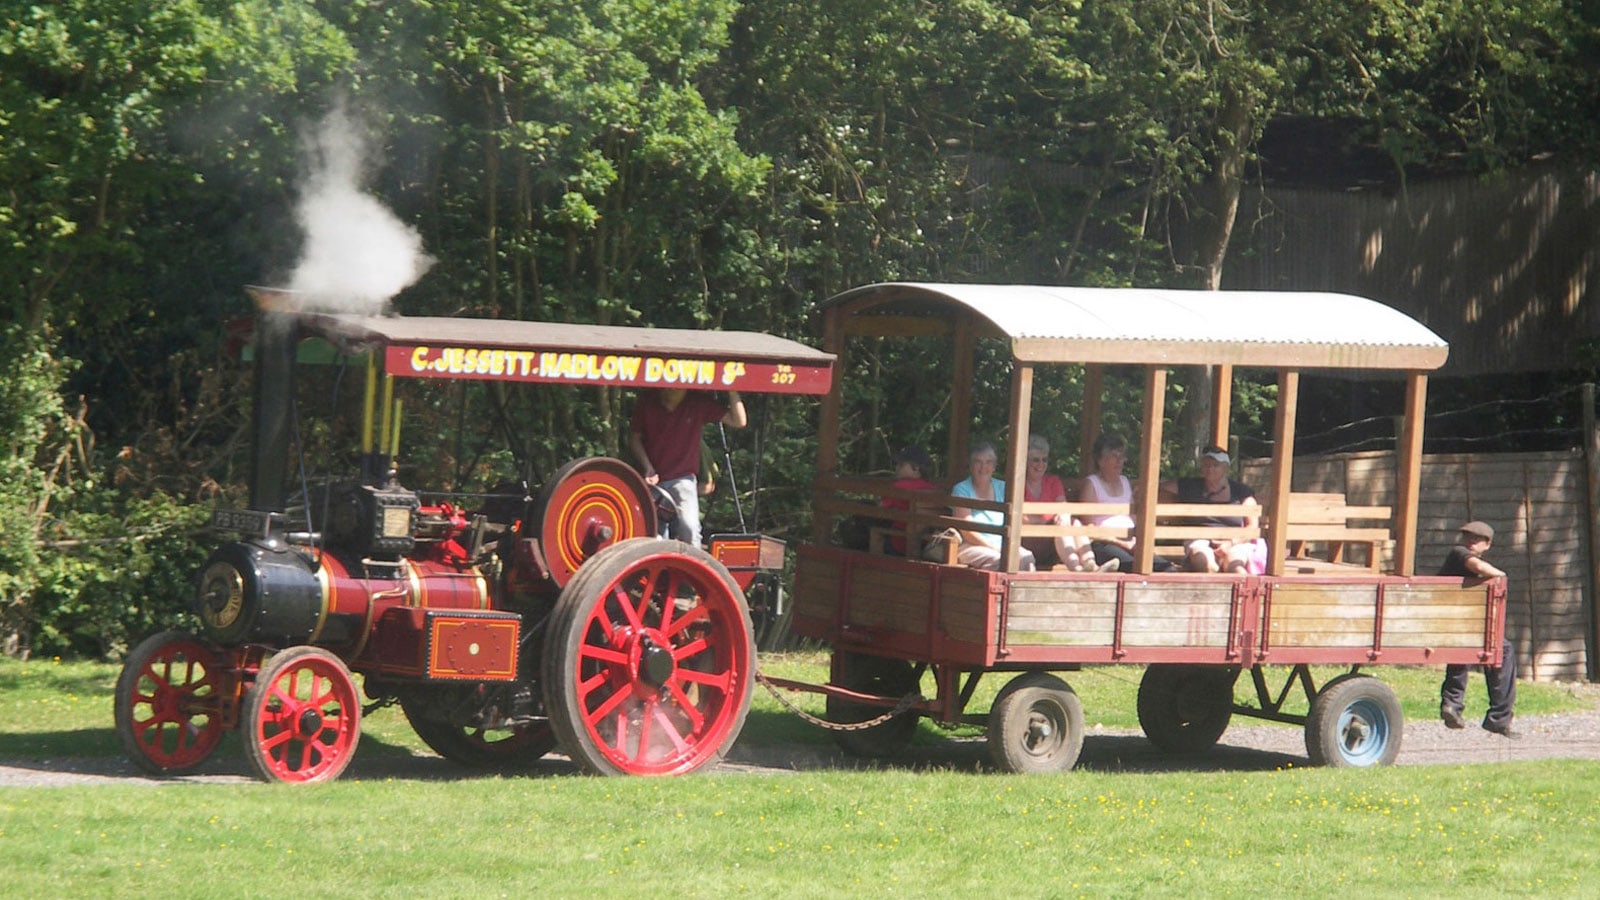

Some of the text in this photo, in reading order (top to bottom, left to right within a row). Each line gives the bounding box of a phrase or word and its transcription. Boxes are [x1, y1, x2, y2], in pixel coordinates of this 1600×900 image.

[539, 352, 641, 381] HADLOW
[645, 357, 715, 385] DOWN
[771, 372, 797, 384] 307
